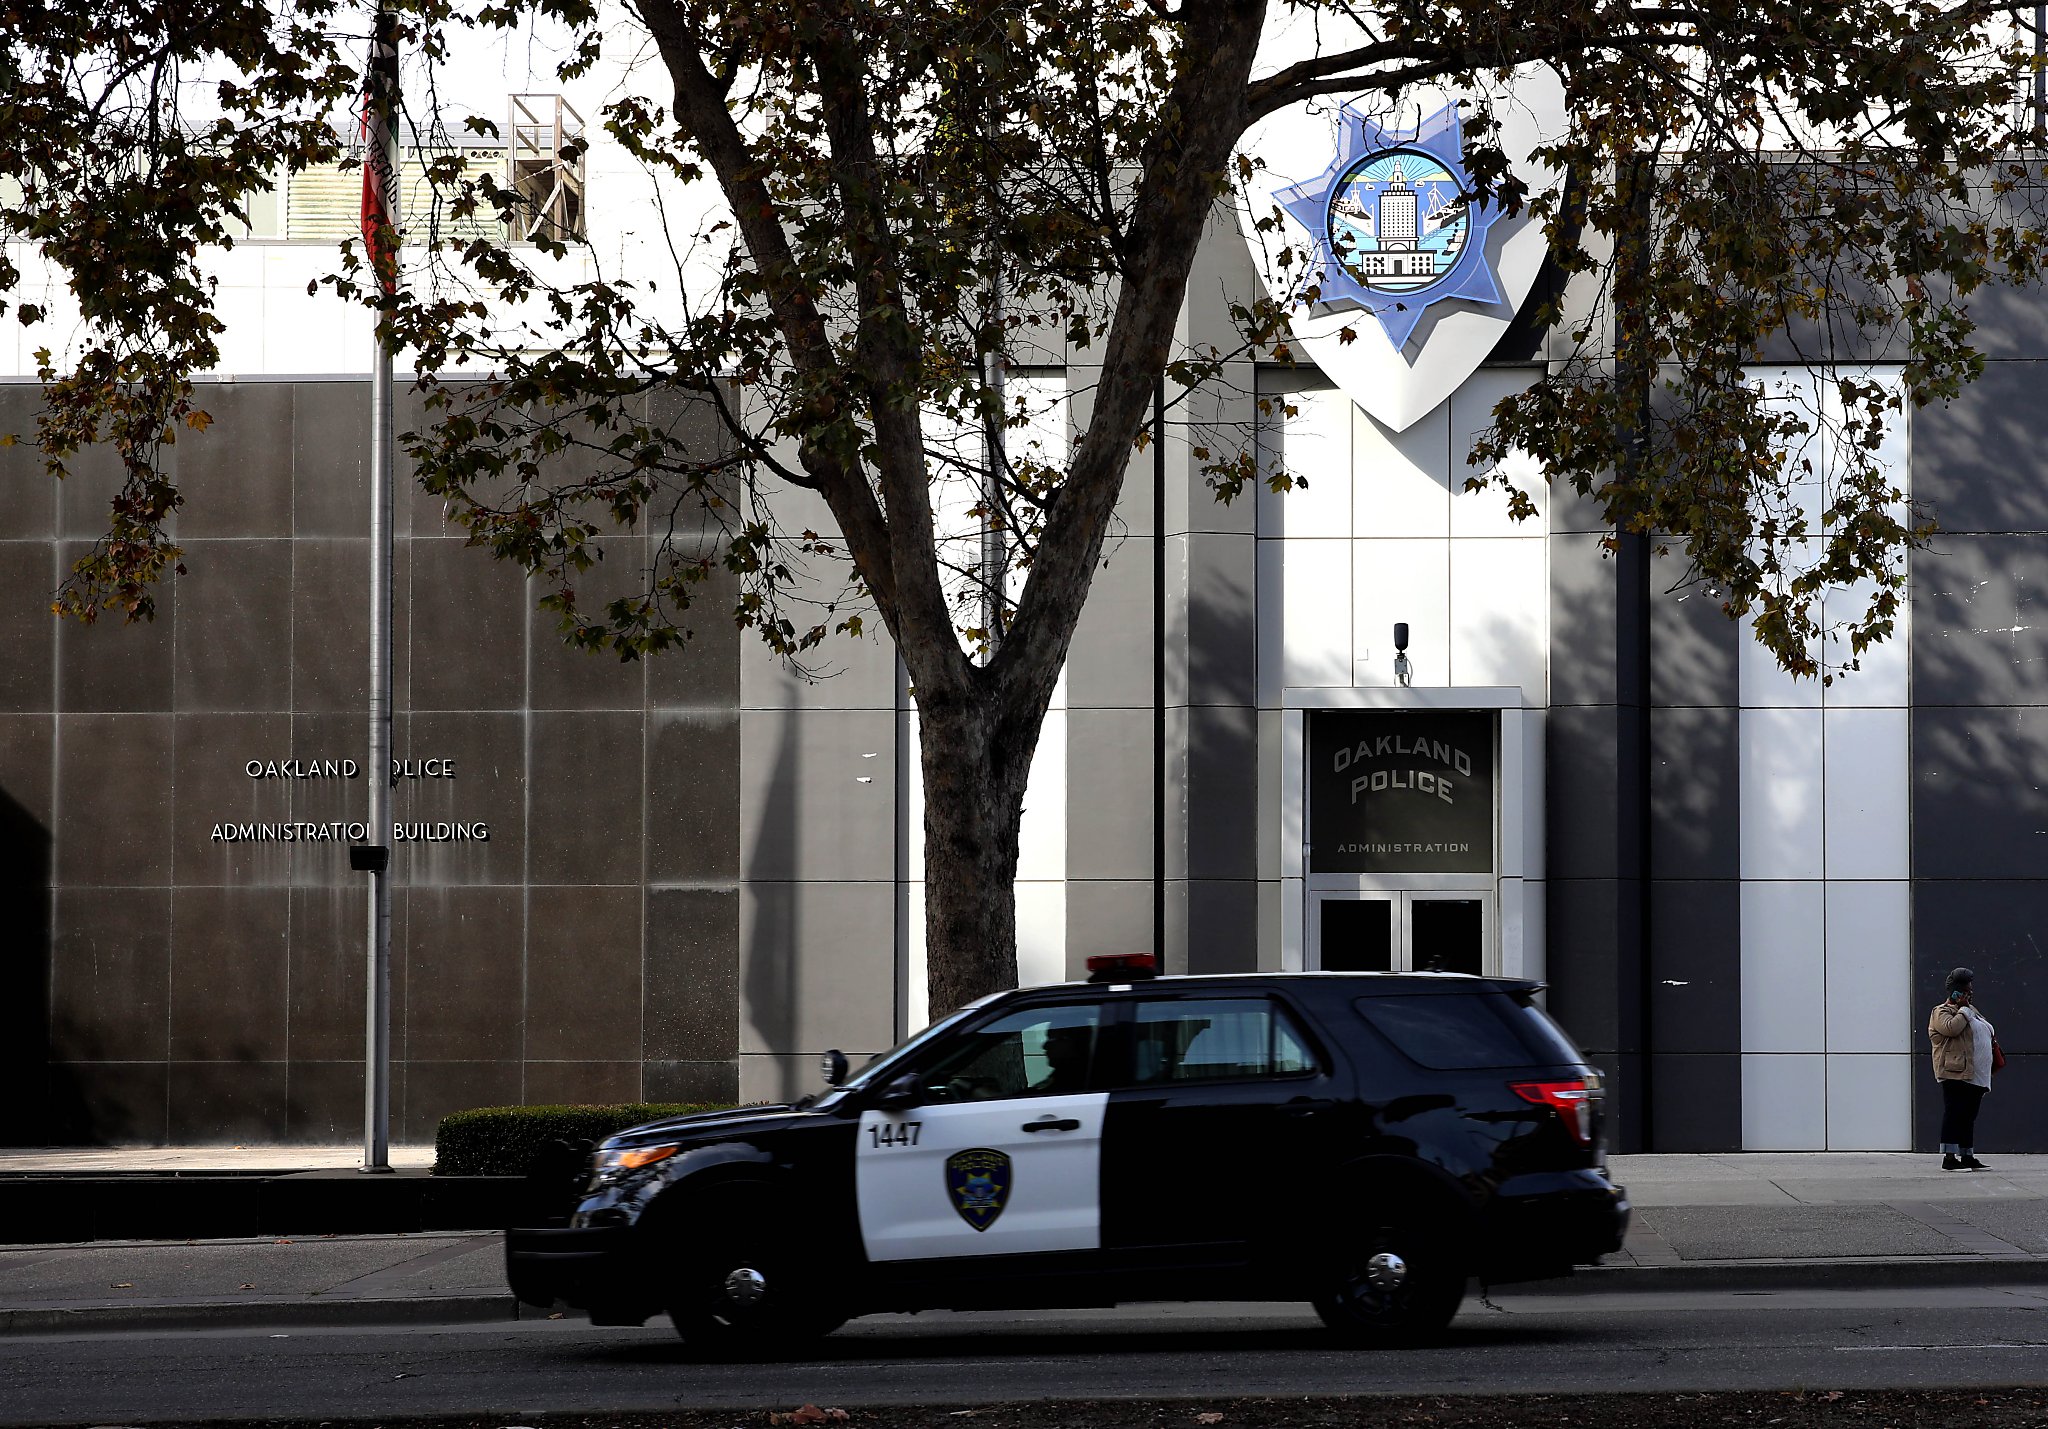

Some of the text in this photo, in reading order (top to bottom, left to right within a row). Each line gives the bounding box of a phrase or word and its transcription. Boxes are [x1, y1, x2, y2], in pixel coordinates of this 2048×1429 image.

[245, 758, 453, 777] OAKLAND LICE
[1334, 735, 1471, 777] OAKLAND
[1351, 769, 1453, 804] POLICE
[210, 822, 488, 841] ADMINISTRATIO BUILDING
[1337, 843, 1469, 853] ADMINISTRATION
[868, 1121, 922, 1148] 1447
